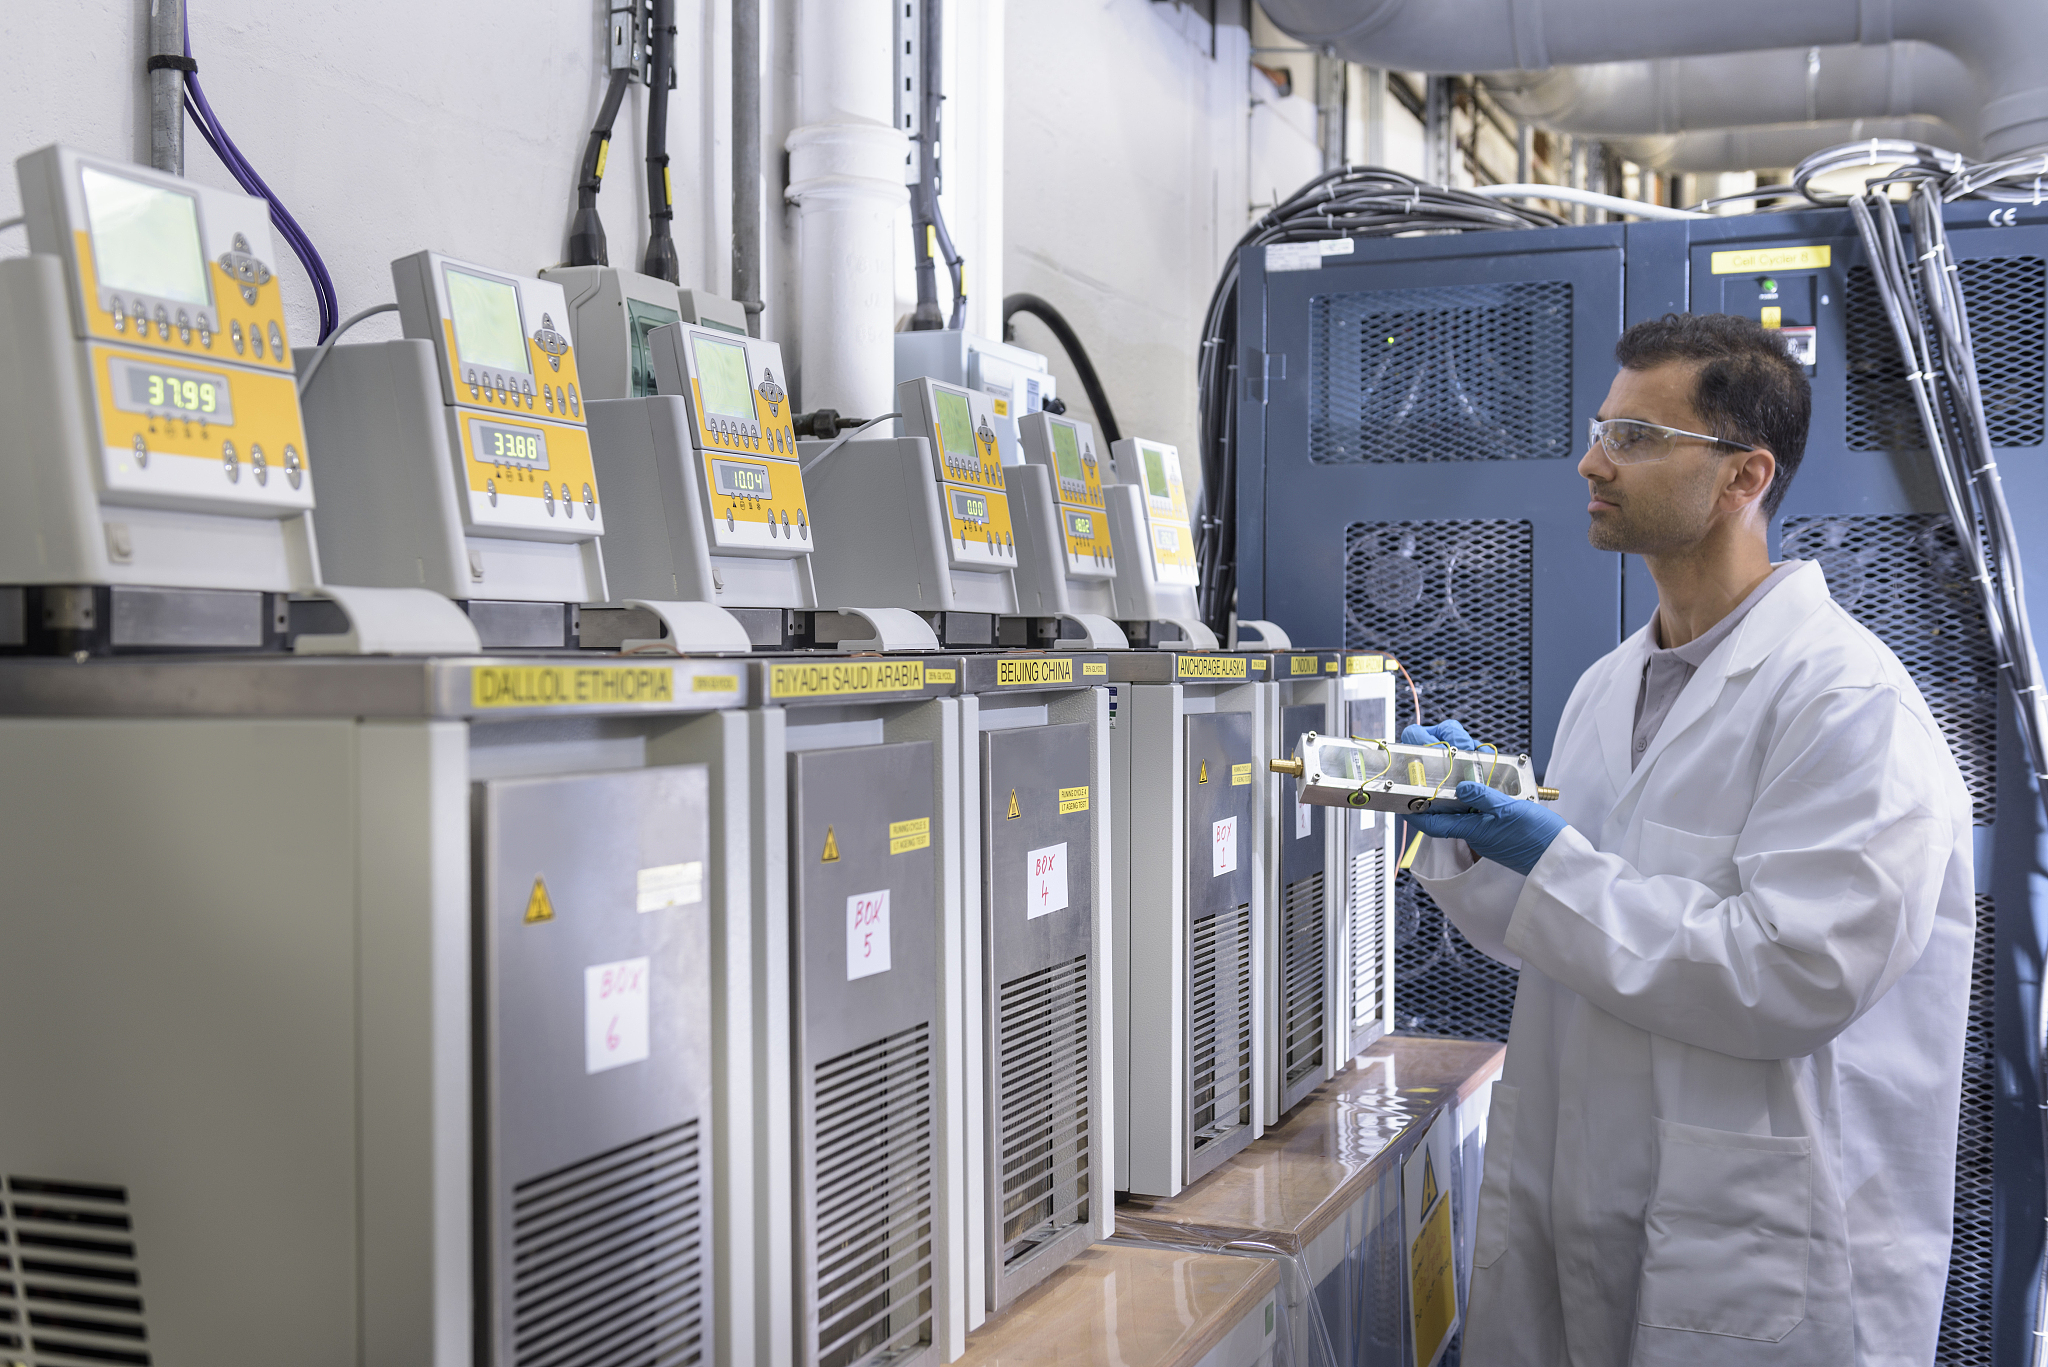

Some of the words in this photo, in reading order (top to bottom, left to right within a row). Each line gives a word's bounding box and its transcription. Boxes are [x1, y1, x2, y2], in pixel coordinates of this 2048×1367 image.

[1988, 207, 2017, 227] CE
[148, 375, 216, 412] 37.99
[494, 432, 538, 459] 33.88
[734, 470, 762, 490] 10.04
[967, 499, 984, 517] 0.00
[1001, 661, 1038, 682] BEIJING
[1042, 661, 1071, 681] CHINA
[1180, 658, 1220, 676] ANCHORAGE
[1222, 659, 1245, 676] ALASKA
[1292, 658, 1310, 673] LONDON
[477, 668, 567, 702] DALLOL
[574, 668, 670, 700] ETHIOPIA
[776, 668, 829, 694] RIYADH
[833, 666, 873, 691] SAUDI
[876, 664, 921, 689] ARABIA
[1078, 800, 1087, 808] TEST
[916, 835, 926, 845] TEST
[1216, 823, 1232, 843] BOX
[1035, 854, 1055, 876] BOX
[1220, 847, 1227, 868] 1
[1041, 880, 1049, 906] 4
[854, 892, 884, 930] BOX
[864, 931, 873, 958] 5
[600, 966, 644, 999] BOX
[605, 1014, 621, 1051] 6
